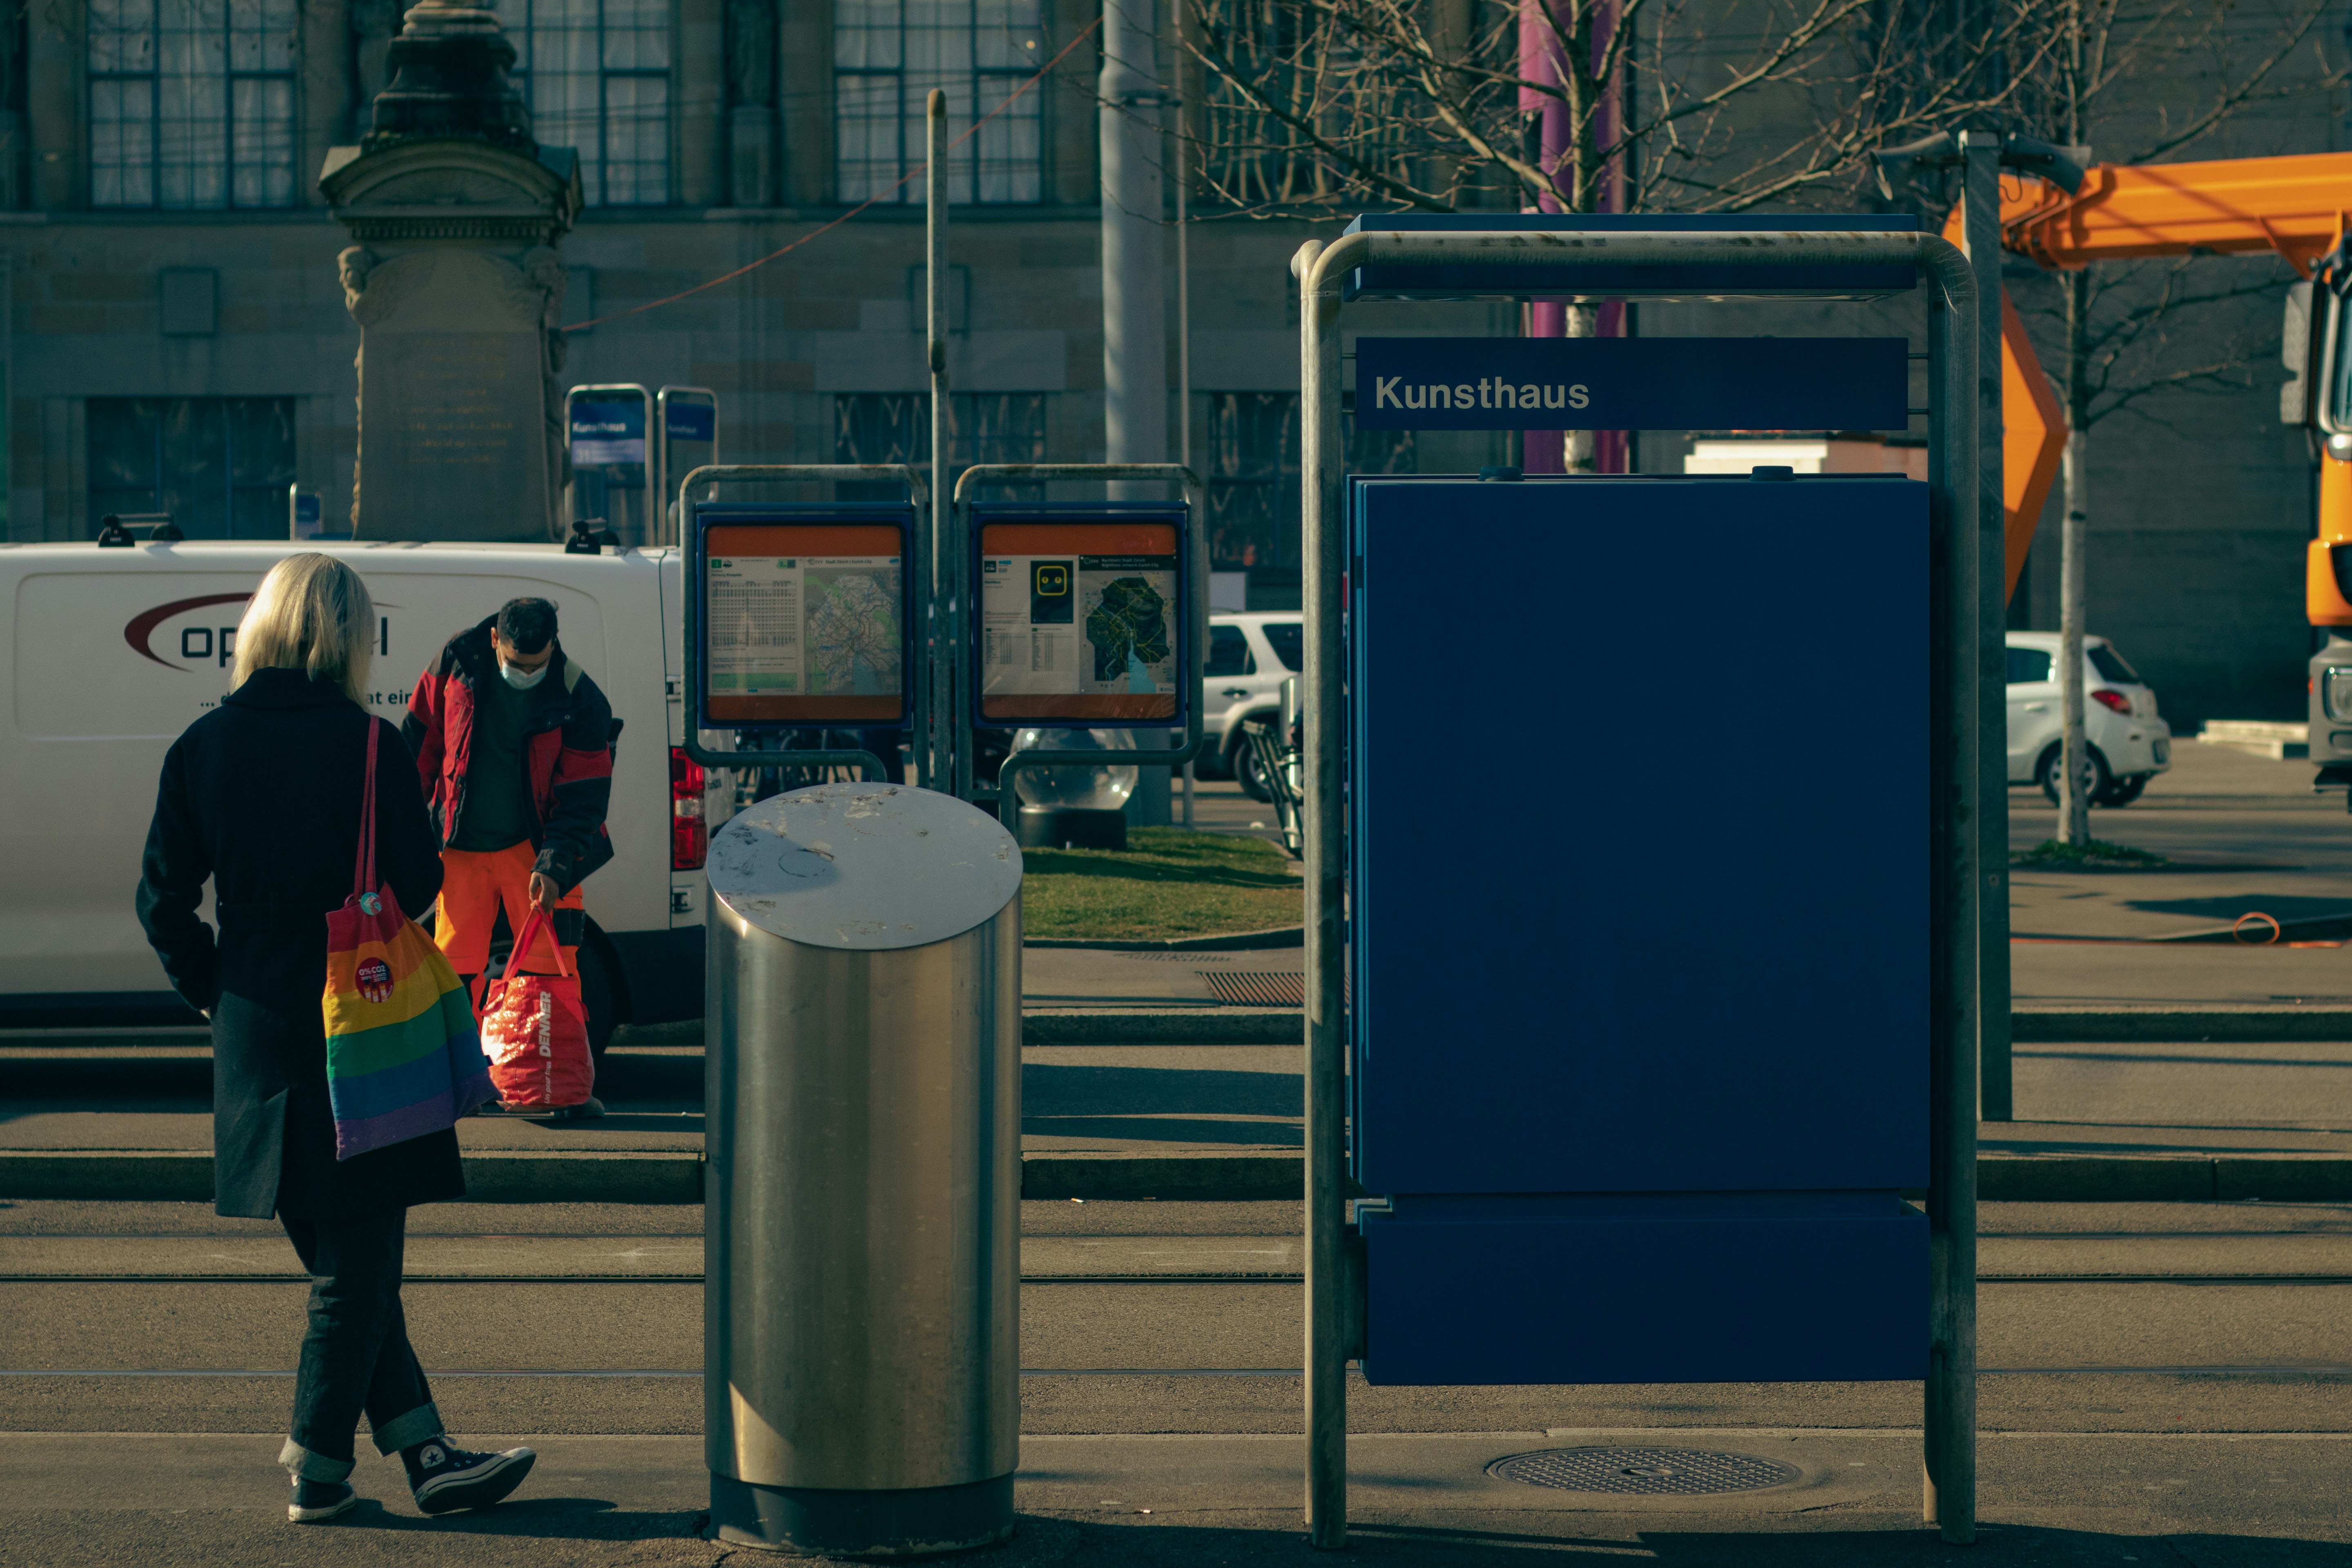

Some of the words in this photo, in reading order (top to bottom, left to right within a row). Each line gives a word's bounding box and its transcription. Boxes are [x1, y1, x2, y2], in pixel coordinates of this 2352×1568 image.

[1376, 376, 1589, 409] Kunsthaus
[359, 968, 371, 976] 0%
[371, 965, 386, 973] CO2
[538, 991, 551, 1057] DENNER
[544, 1093, 551, 1104] Un
